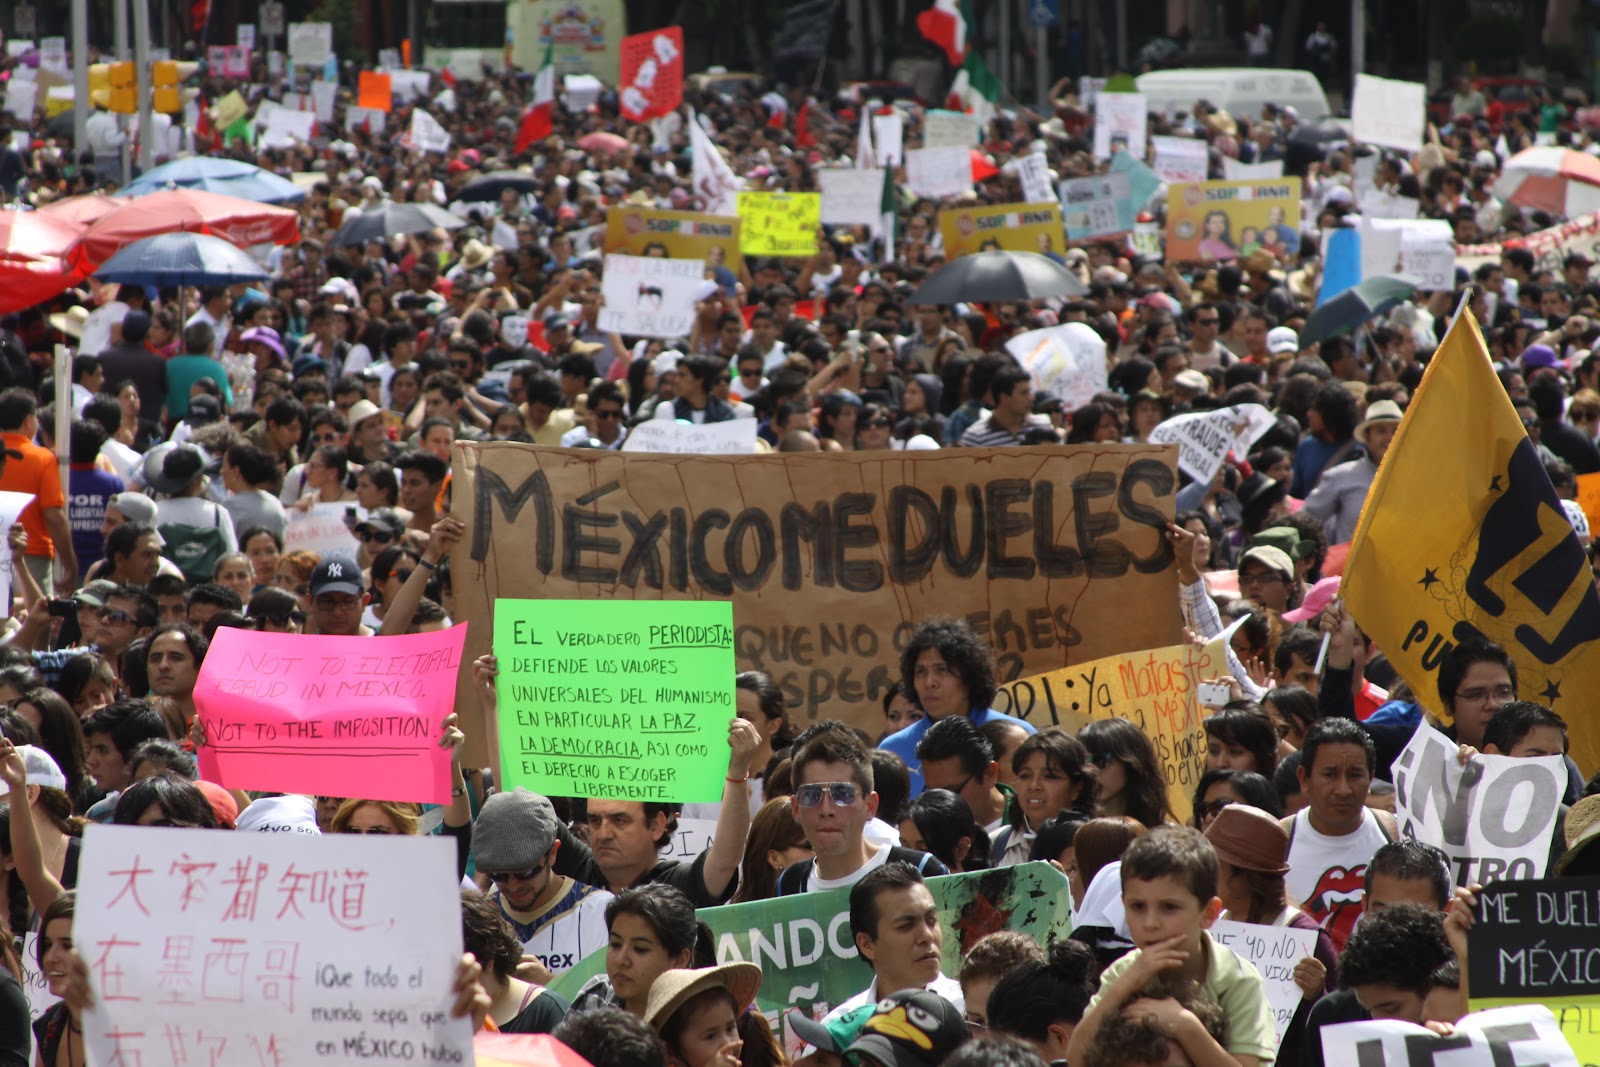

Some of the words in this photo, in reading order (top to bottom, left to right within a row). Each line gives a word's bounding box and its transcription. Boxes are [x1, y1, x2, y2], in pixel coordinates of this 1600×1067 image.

[513, 620, 543, 645] EL
[556, 630, 641, 647] VERDADERO
[648, 624, 733, 648] PERIODISTA:
[237, 650, 303, 676] NOT
[320, 656, 345, 676] TO
[511, 657, 589, 674] DEFIENDE
[596, 658, 618, 674] LOS
[621, 659, 678, 675] VALORES
[213, 677, 288, 698] FRAUD
[300, 681, 326, 699] IN
[511, 684, 613, 704] UNIVERSALES
[620, 687, 648, 705] DEL
[655, 686, 732, 707] HUMANISMO
[206, 717, 246, 742] NOT
[254, 723, 277, 741] TO
[283, 719, 323, 739] THE
[516, 710, 540, 728] EN
[544, 711, 632, 731] PARTICULAR
[640, 713, 657, 731] LA
[520, 735, 537, 753] LA
[647, 742, 670, 756] ASI
[675, 743, 708, 758] COMO
[522, 761, 540, 775] EL
[544, 761, 600, 779] DERECHO
[607, 765, 615, 779] A
[619, 766, 677, 782] ESCOGER
[573, 781, 675, 799] LIBREMENTE.
[1453, 856, 1536, 889] TRO
[1481, 892, 1521, 924] ME
[1537, 890, 1600, 927] DUEL
[364, 967, 400, 990] todo
[408, 964, 424, 990] el
[310, 1001, 363, 1025] mundo
[371, 1006, 410, 1031] sepa
[315, 1041, 338, 1056] en
[343, 1030, 416, 1060] MÉXICO
